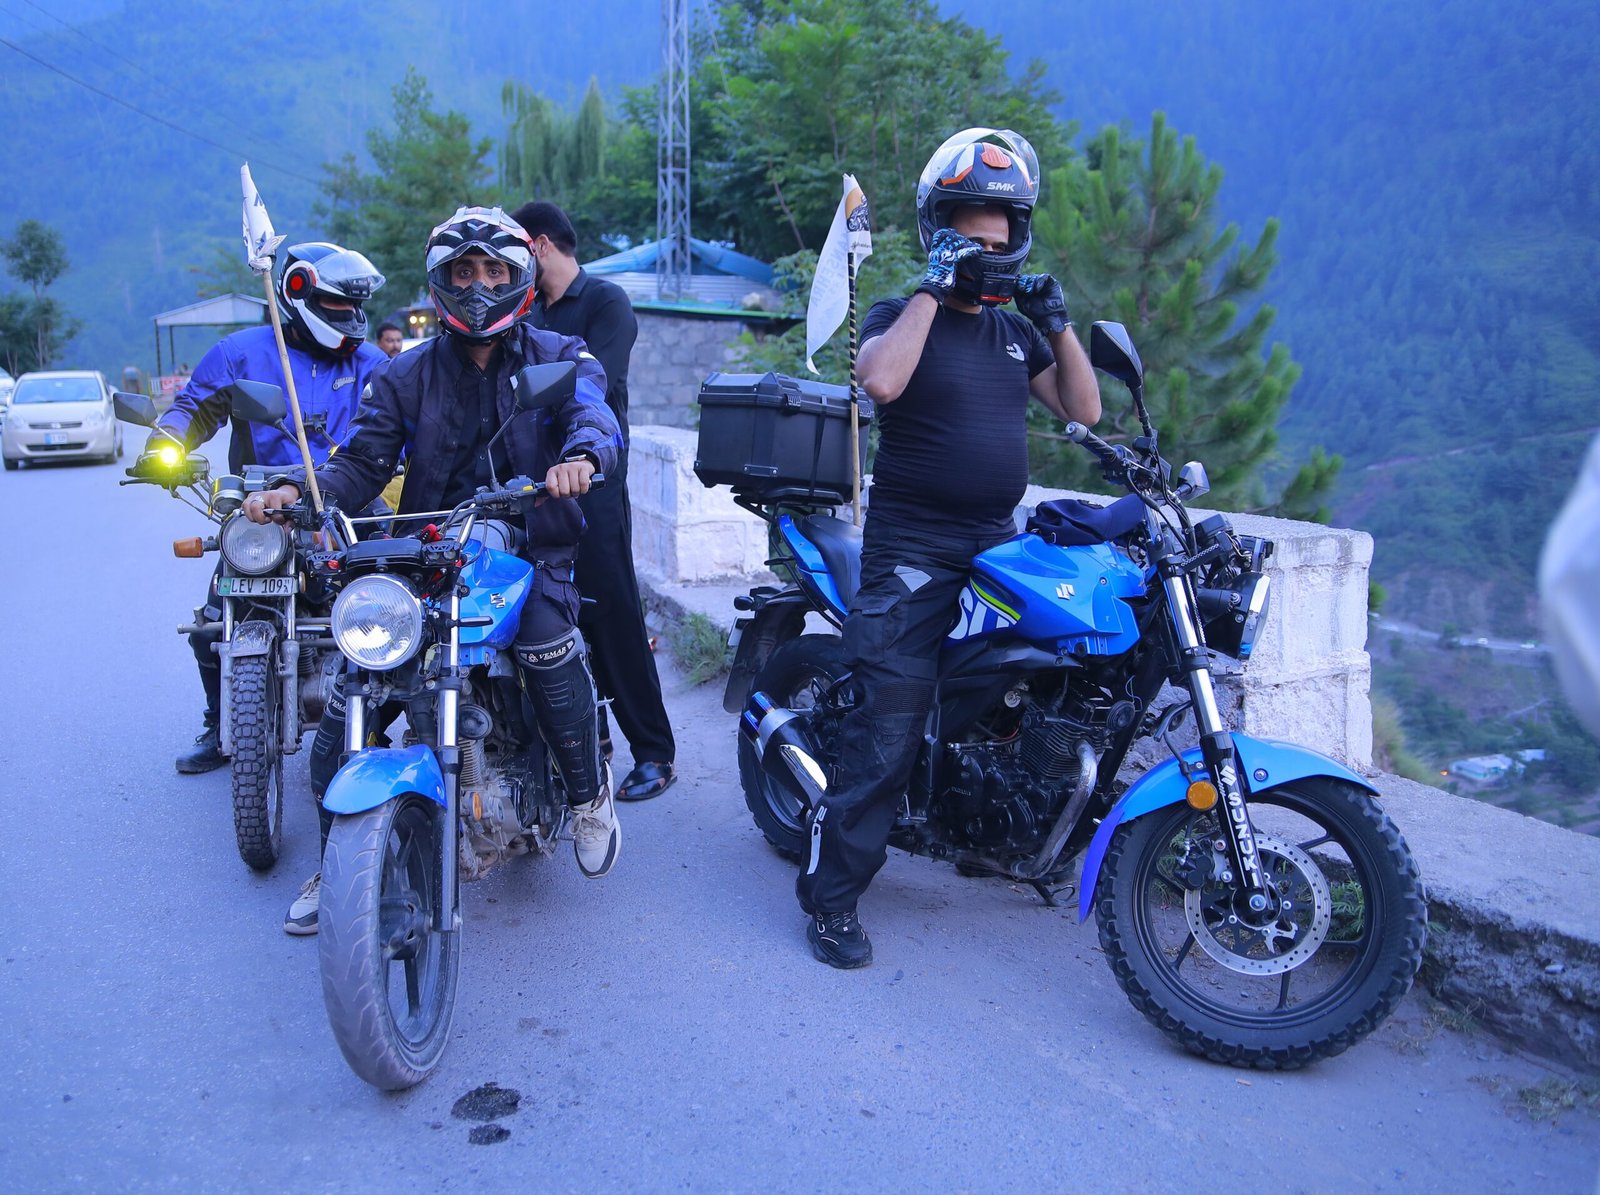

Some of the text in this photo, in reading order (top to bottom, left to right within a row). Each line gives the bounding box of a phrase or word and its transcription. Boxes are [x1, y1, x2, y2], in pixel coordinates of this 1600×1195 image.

[986, 181, 1016, 192] SMK
[231, 578, 283, 594] LEV 109
[539, 646, 567, 660] VEMAR
[1228, 791, 1260, 887] SUZUKI
